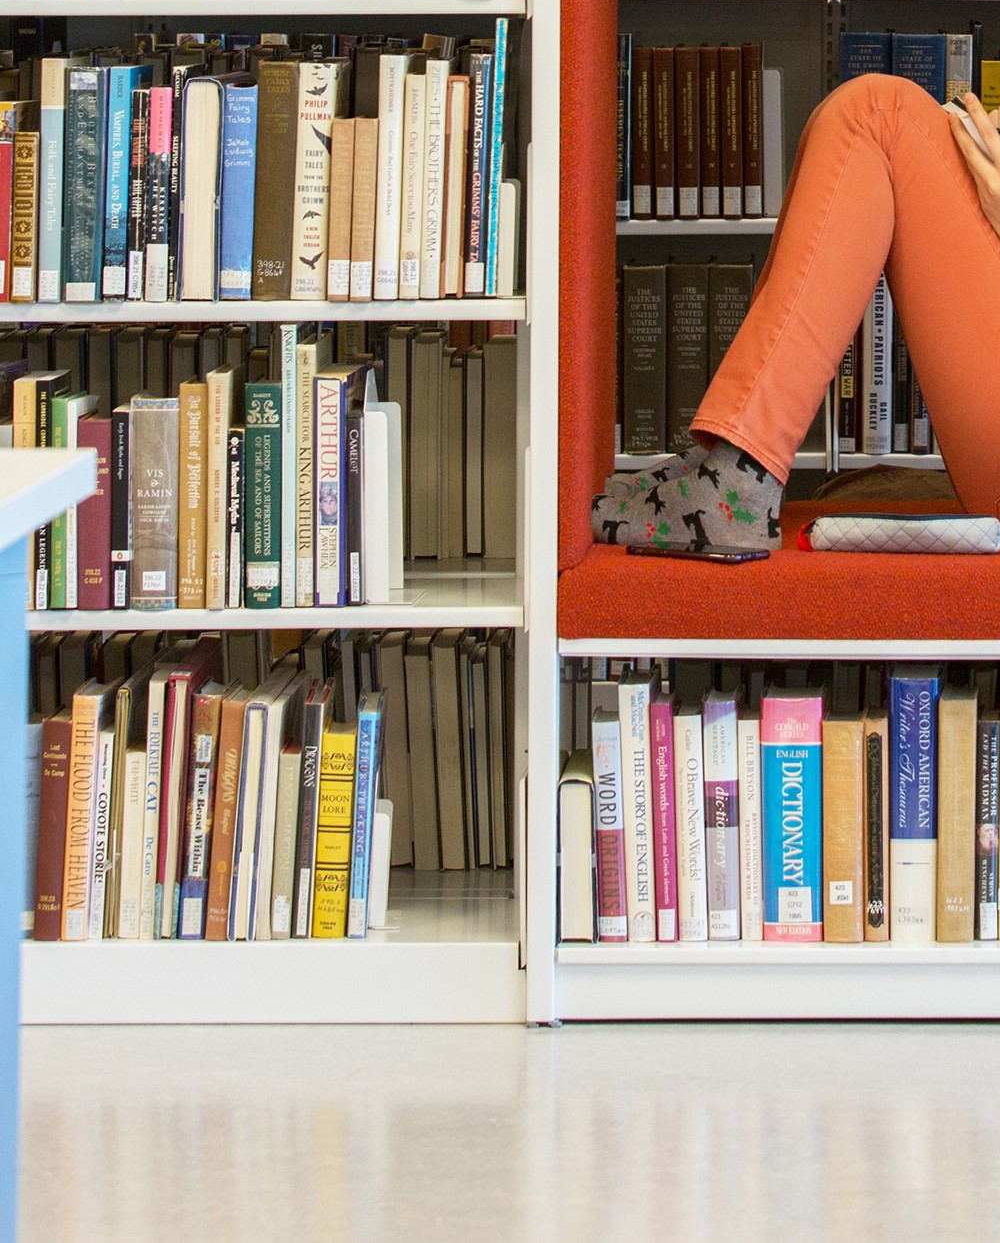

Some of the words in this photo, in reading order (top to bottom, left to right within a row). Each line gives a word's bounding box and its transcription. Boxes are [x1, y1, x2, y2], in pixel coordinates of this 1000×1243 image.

[228, 104, 250, 114] Fairy
[304, 99, 328, 108] PHILIP
[226, 115, 251, 124] Tales
[300, 112, 332, 120] PULLMAN
[305, 149, 324, 158] FAIRY
[305, 161, 324, 169] TALES
[297, 184, 330, 193] BROTHERS
[302, 196, 324, 205] GRIMM
[874, 336, 884, 386] PATRIOTS
[319, 385, 339, 480] ARTHUR
[146, 459, 164, 467] VIS
[299, 447, 311, 484] KING
[136, 488, 173, 497] RAMIN
[298, 490, 312, 551] ARTHUR
[918, 691, 931, 751] OXFORD
[776, 749, 808, 758] ENGLISH
[633, 750, 645, 775] THE
[320, 794, 350, 803] MOON
[598, 772, 617, 826] WORD
[634, 779, 646, 816] STORY
[918, 756, 931, 829] AMERICAN
[322, 805, 346, 814] LORE
[635, 819, 647, 838] OF
[781, 761, 804, 885] DICTIONARY
[600, 834, 620, 911] ORIGINS
[636, 840, 649, 903] ENGLISH
